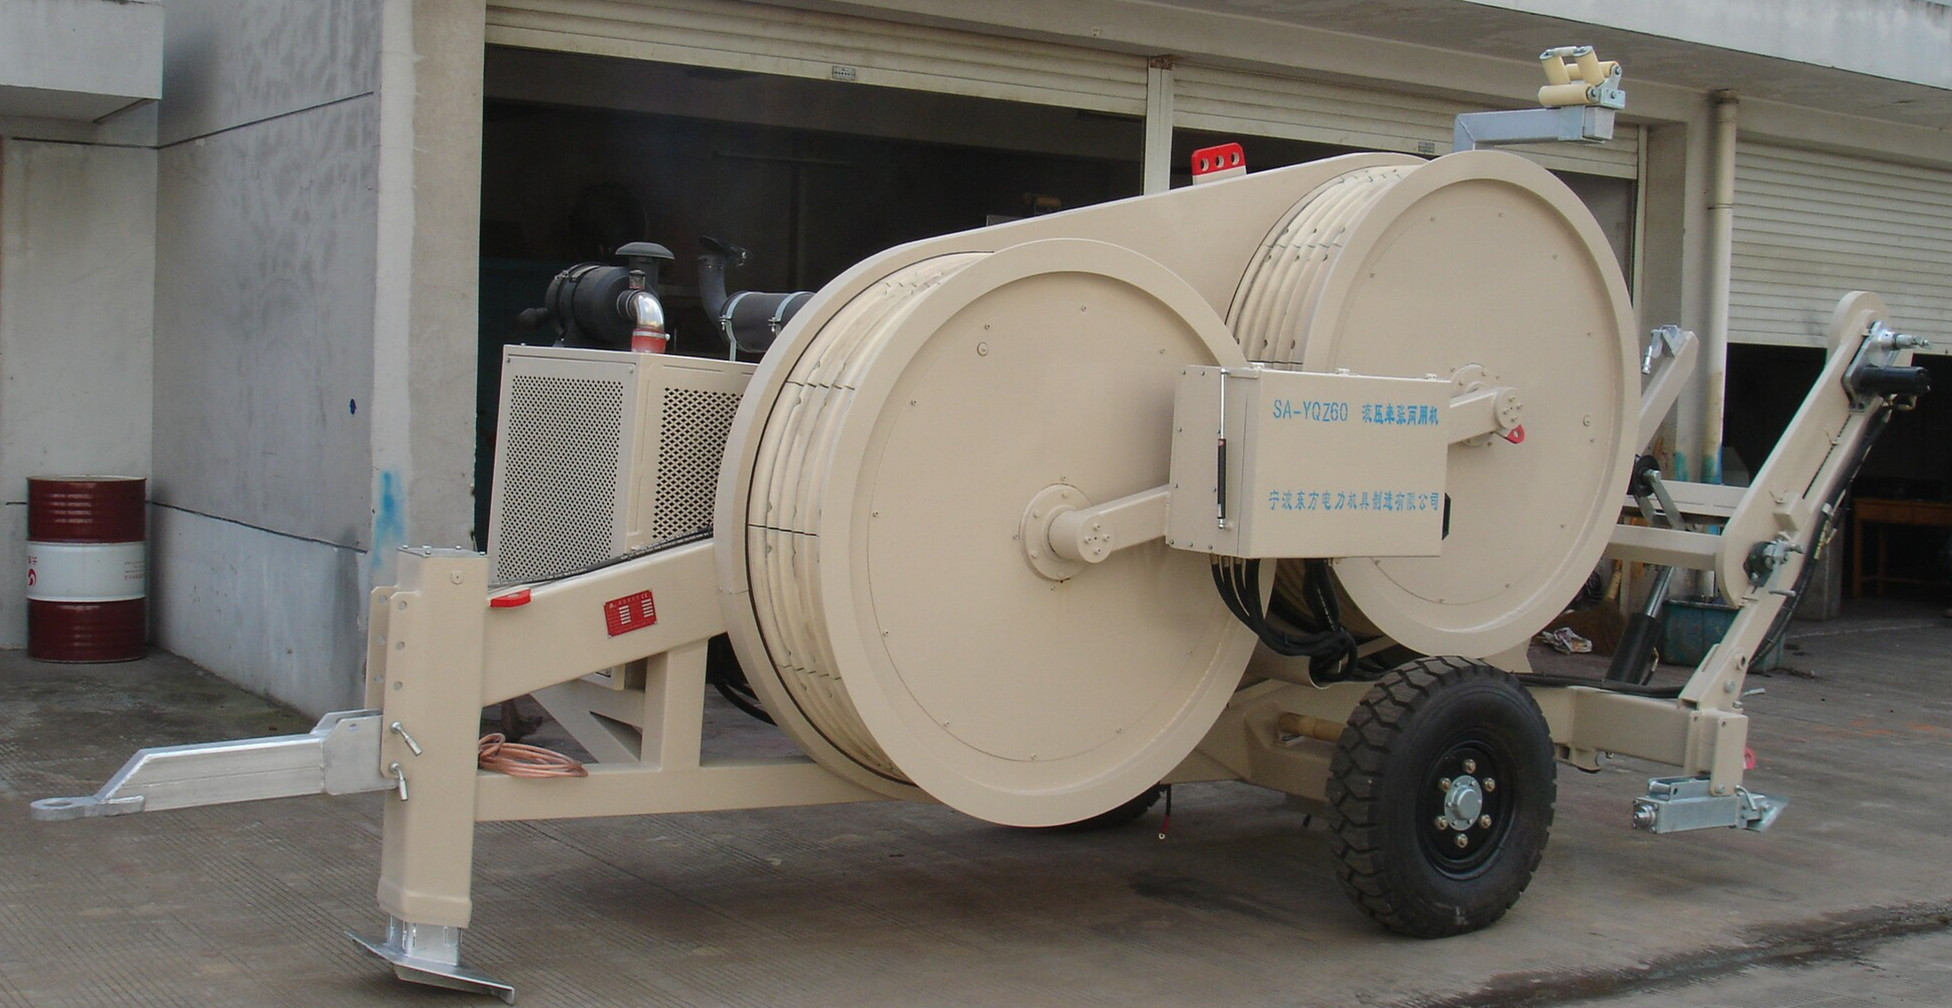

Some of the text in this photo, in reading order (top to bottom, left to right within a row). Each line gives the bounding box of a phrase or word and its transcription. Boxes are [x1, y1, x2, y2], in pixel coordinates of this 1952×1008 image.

[1273, 399, 1349, 422] SA-YQZ60
[1269, 489, 1439, 511] 宁波东方电力机具制造有限公司
